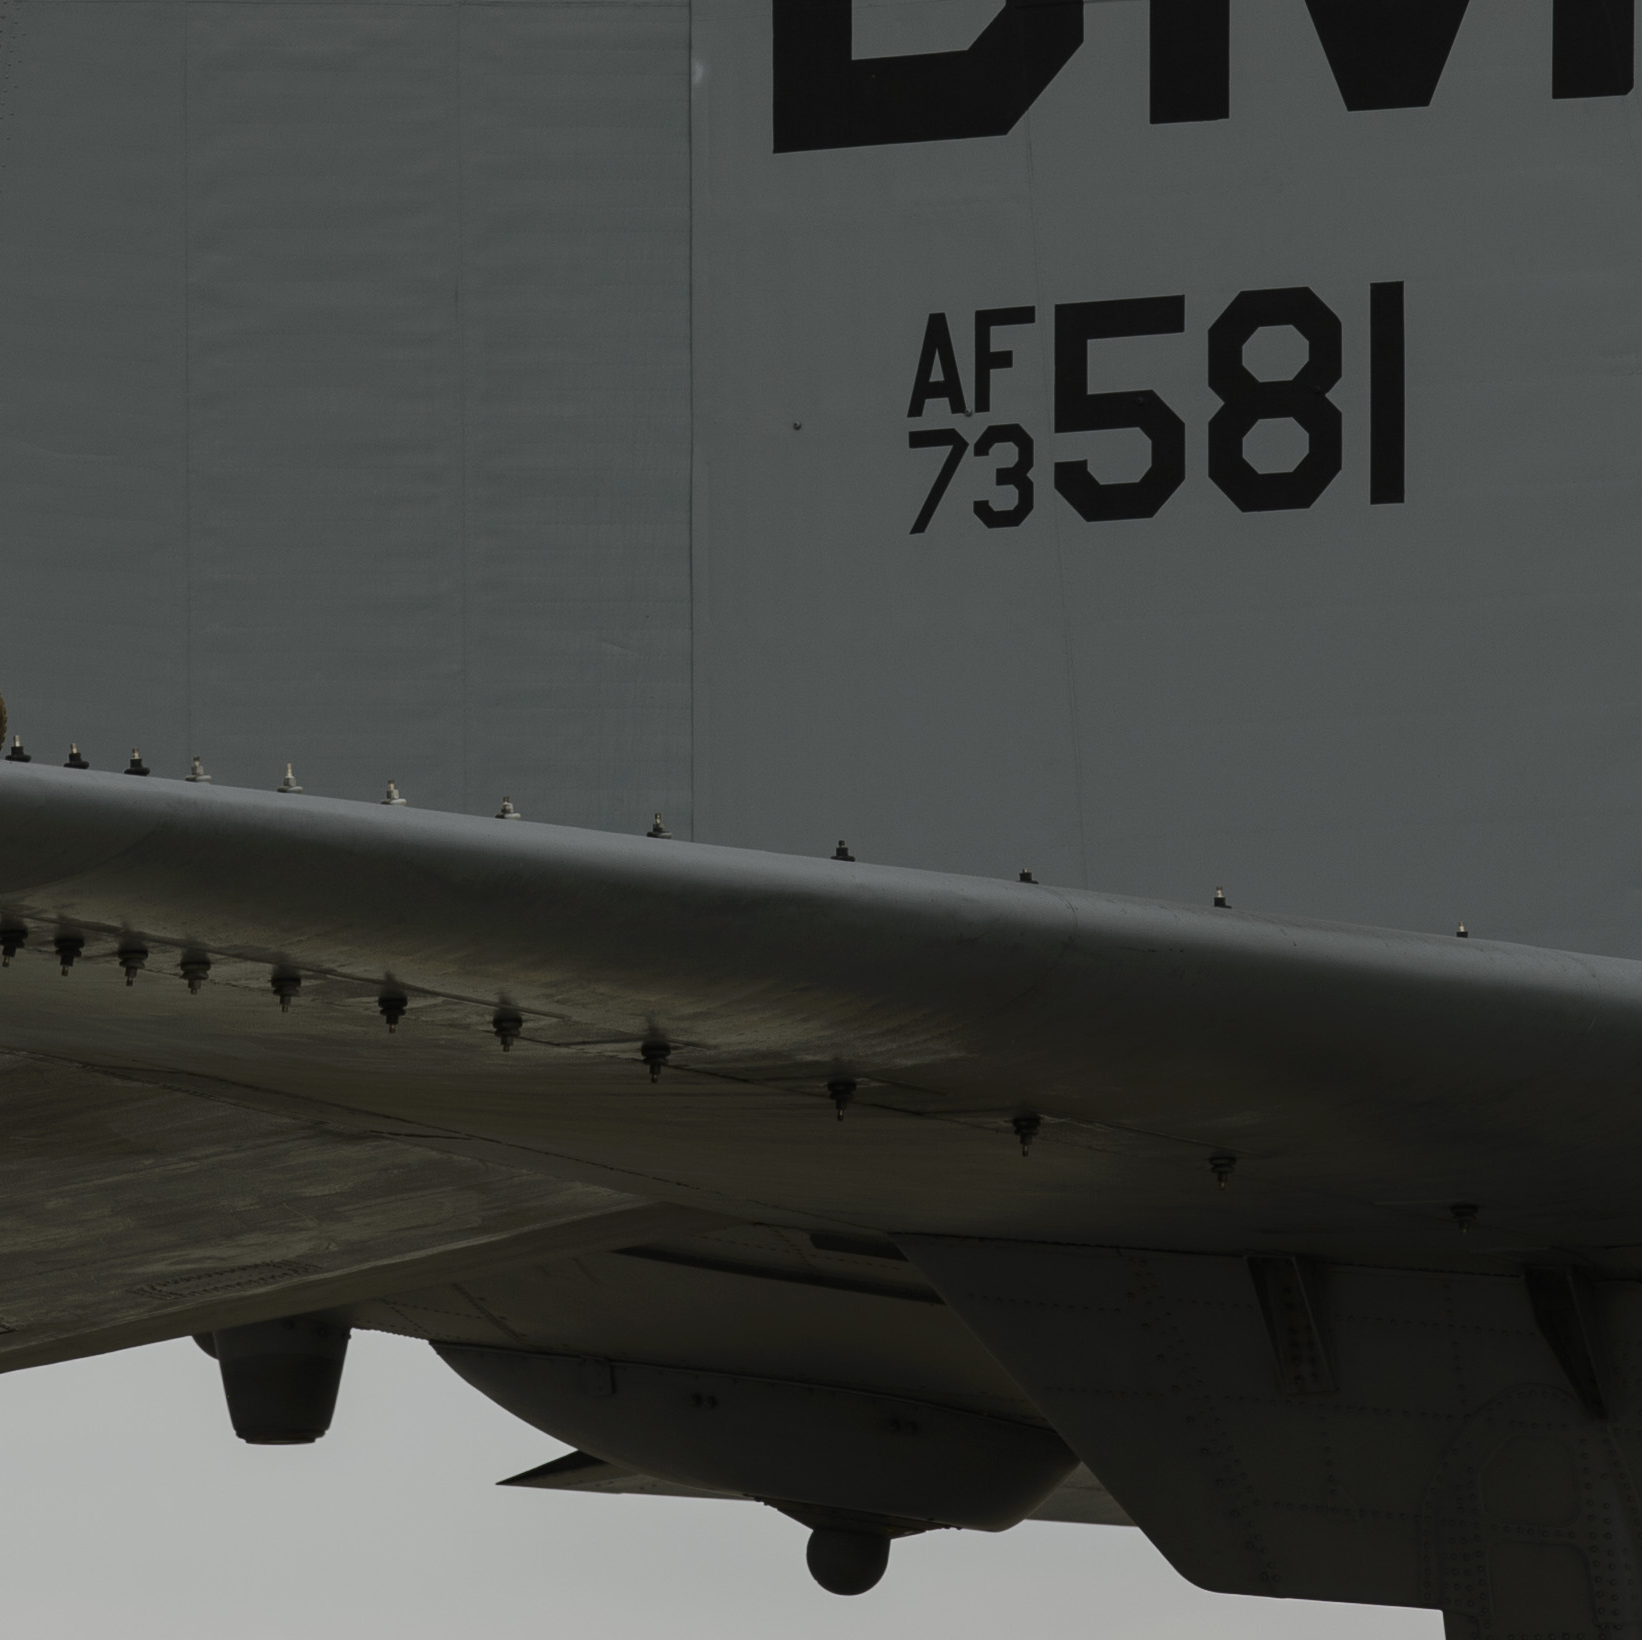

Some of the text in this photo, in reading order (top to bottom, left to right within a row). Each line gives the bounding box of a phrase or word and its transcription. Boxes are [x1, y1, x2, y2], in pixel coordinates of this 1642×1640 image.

[906, 305, 1036, 418] AF
[1054, 280, 1405, 523] 581
[908, 423, 1034, 535] 73
